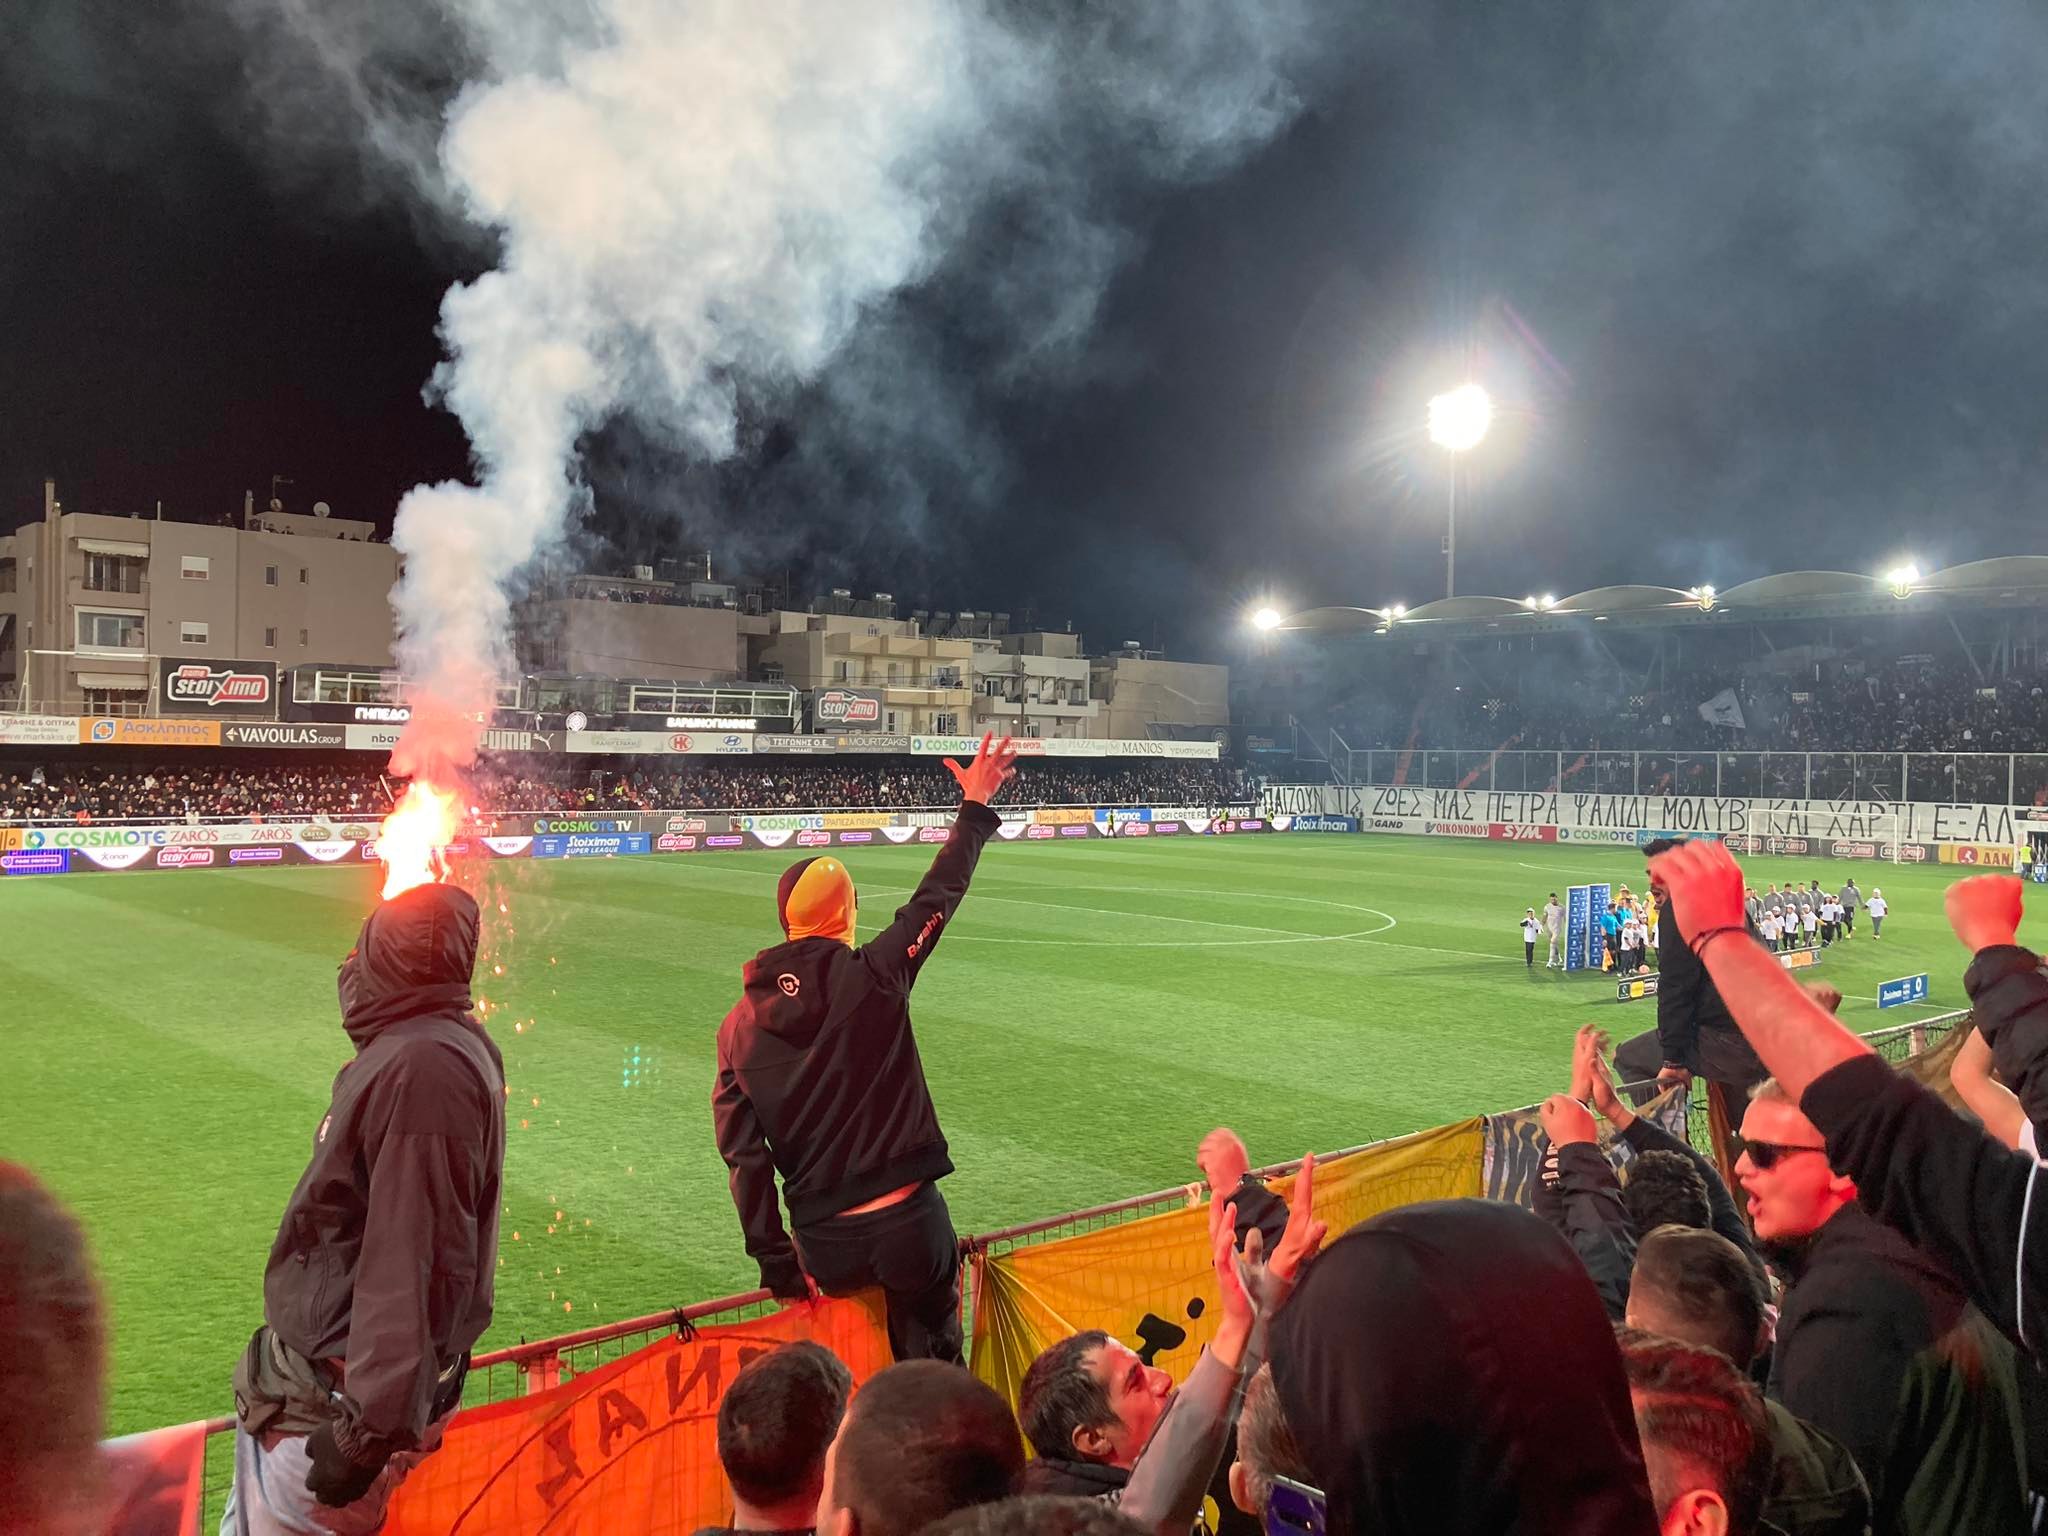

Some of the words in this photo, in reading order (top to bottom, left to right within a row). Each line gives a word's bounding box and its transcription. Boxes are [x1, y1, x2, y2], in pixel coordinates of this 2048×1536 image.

[239, 728, 318, 744] VAVOULAS
[318, 735, 342, 744] GROUP
[926, 741, 980, 751] COSMOTE
[1122, 743, 1163, 754] MANIOS
[1333, 787, 1363, 815] ΤΙΣ
[1373, 788, 1424, 816] ΖΩΕΣ
[1433, 790, 1476, 820] ΜΑΣ
[1486, 792, 1558, 824] ΠΕΤΡΑ
[1574, 794, 1649, 829] ΨΑΛΙΔΙ
[1767, 800, 1810, 836] ΚΑΙ
[1827, 801, 1915, 839] ΧΑΡΤΙ
[550, 819, 615, 833] COSMOTE
[616, 820, 632, 832] TV
[758, 817, 823, 830] COSMOTE
[1293, 817, 1348, 832] Stoiximan
[1375, 820, 1403, 828] GAND
[1436, 823, 1488, 835] ΟΙΚΟΝΟΜΟΥ
[54, 831, 166, 846] COSMOTE
[1502, 825, 1543, 840] SYM
[1574, 830, 1634, 842] COSMOTE
[567, 836, 620, 846] Stoiximan
